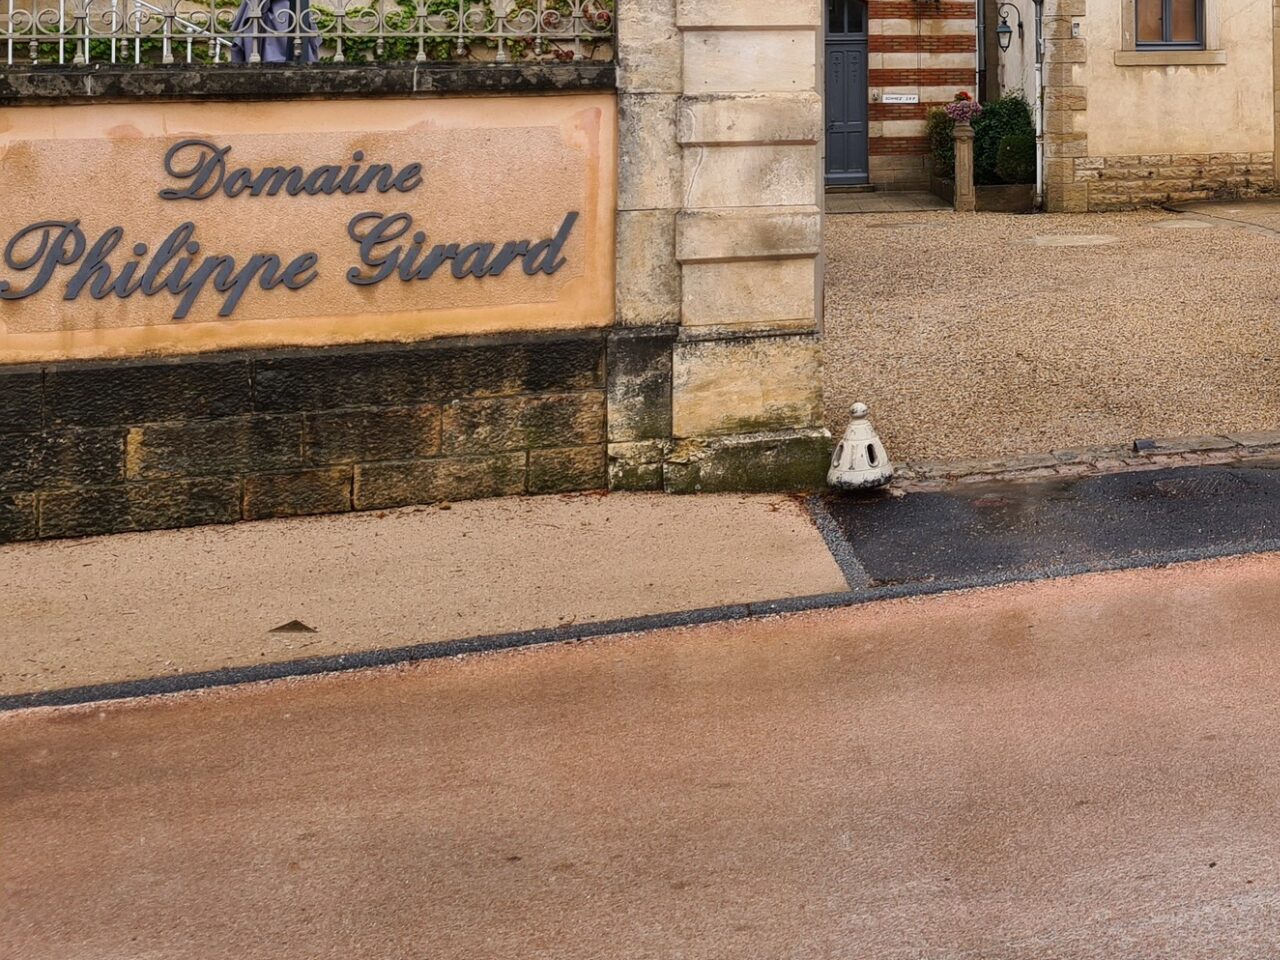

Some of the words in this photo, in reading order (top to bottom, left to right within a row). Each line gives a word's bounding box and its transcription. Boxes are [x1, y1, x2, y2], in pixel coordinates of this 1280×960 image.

[159, 139, 423, 201] Domaine
[0, 218, 318, 319] Philippe
[346, 211, 580, 286] Girard
